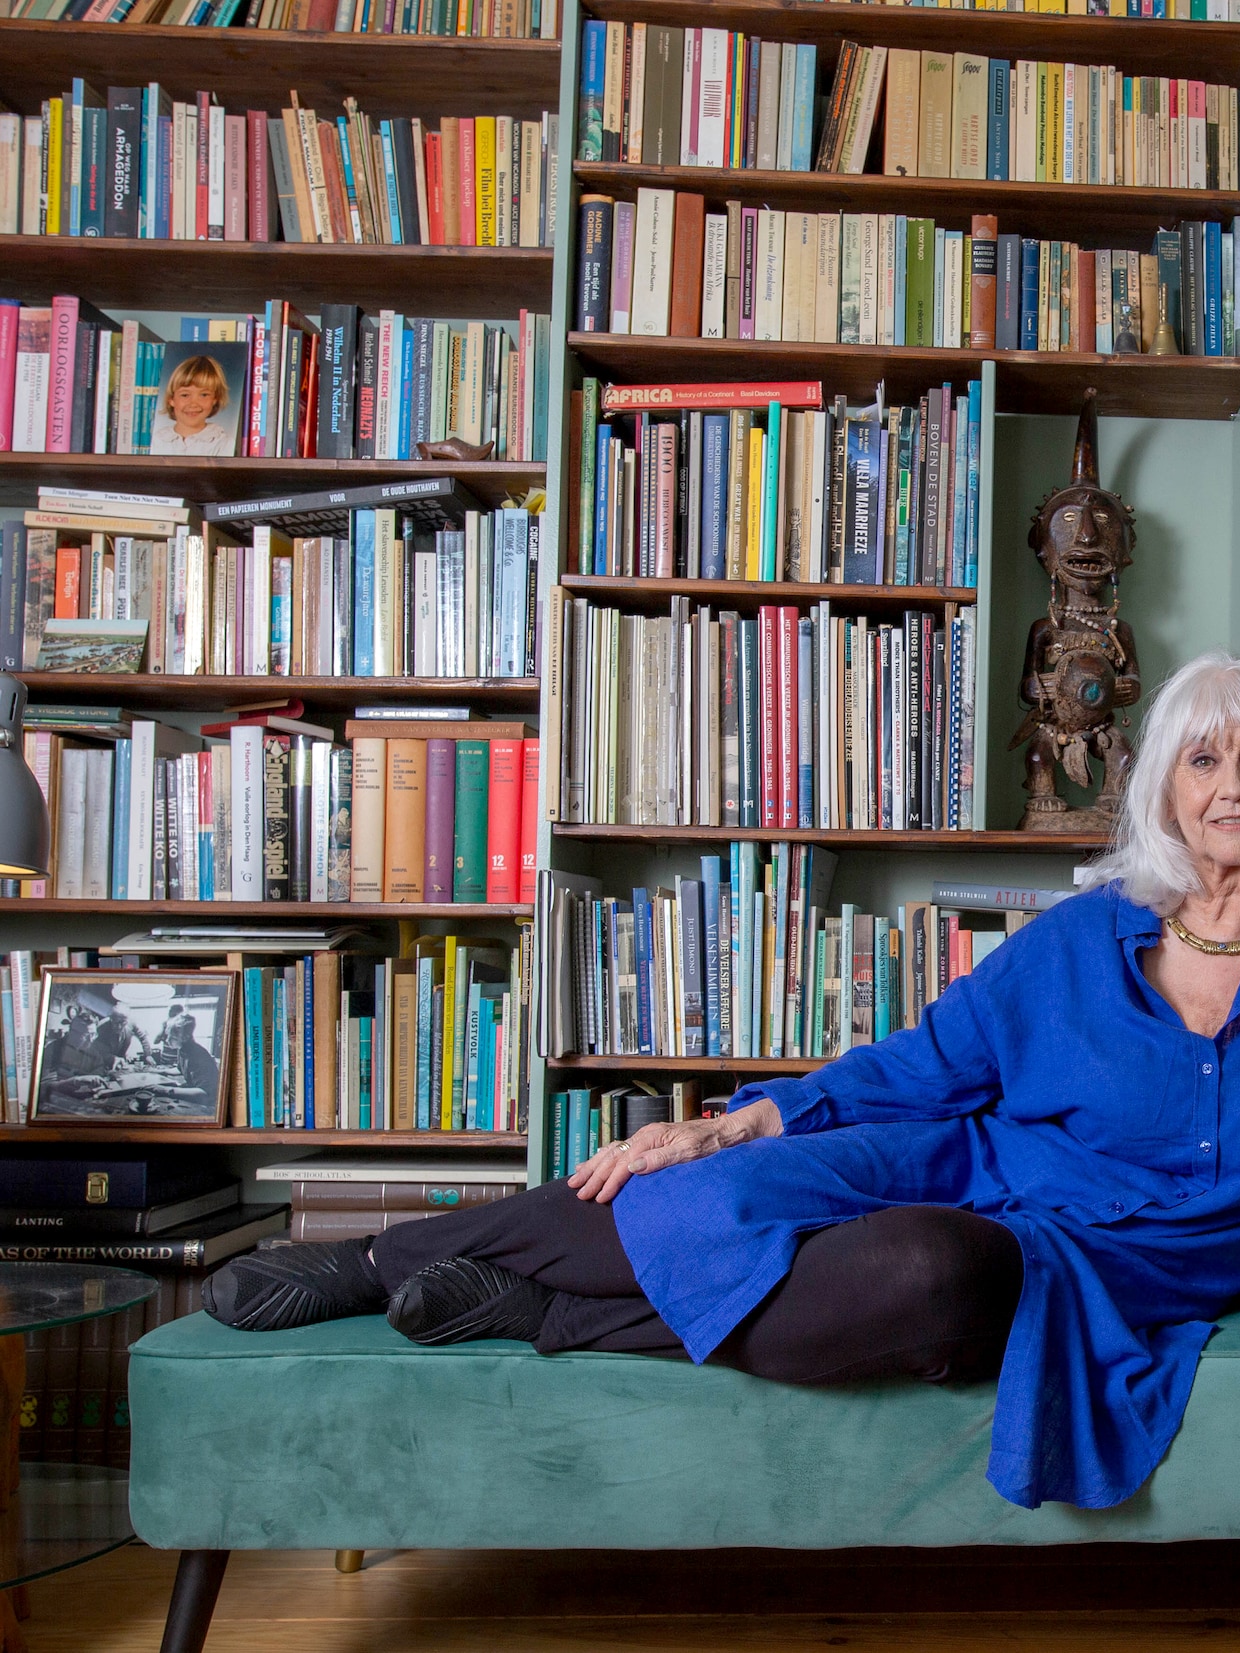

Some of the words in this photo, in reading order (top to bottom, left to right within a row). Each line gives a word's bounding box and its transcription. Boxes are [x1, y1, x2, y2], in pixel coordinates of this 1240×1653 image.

[124, 143, 131, 154] OP
[114, 128, 125, 210] ARMAGEDDON
[481, 168, 492, 192] Film
[481, 194, 492, 210] bei
[481, 212, 492, 246] Brecht
[594, 211, 603, 243] NADINE
[592, 262, 600, 276] Een
[333, 326, 343, 364] Wilhelm
[364, 332, 374, 357] Michael
[53, 313, 70, 444] OORLOGSGASTEN
[333, 377, 342, 386] in
[364, 359, 373, 384] Schmidt
[418, 373, 426, 417] RUSSISCHE
[606, 388, 672, 404] AFRICA
[331, 388, 341, 433] Nederland
[360, 387, 373, 439] NEONAZI'S
[929, 424, 939, 466] BOVEN
[856, 459, 870, 488] VILLA
[929, 474, 938, 488] DE
[329, 493, 345, 503] VOOR
[382, 488, 390, 498] DE
[392, 485, 405, 497] OUDE
[406, 482, 440, 495] HOUTHAVEN
[219, 504, 234, 516] EEN
[236, 502, 260, 514] PAPIEREN
[260, 499, 292, 513] MONUMENT
[928, 495, 937, 527] STAD
[854, 493, 869, 554] MAARHEEZE
[380, 534, 389, 574] slavenschip
[529, 526, 538, 561] COCAINE
[64, 571, 74, 598] Berlijn
[266, 754, 288, 819] England
[155, 799, 164, 838] WITTE
[168, 798, 177, 836] WITTE
[155, 841, 164, 859] KO
[168, 840, 177, 858] KO
[243, 845, 251, 862] Haag
[263, 840, 288, 880] spiel
[429, 855, 436, 866] 2
[492, 855, 504, 866] 12
[523, 854, 534, 865] 12
[457, 857, 464, 868] 3
[996, 891, 1036, 906] ATJEH
[687, 918, 696, 941] JUIST!
[687, 943, 696, 974] IJMOND
[720, 940, 730, 952] DE
[708, 923, 719, 1020] VELSEN-IJMUIDEN
[720, 954, 730, 990] VELSER
[720, 992, 730, 1029] AFFAIRE
[470, 1011, 478, 1058] KUSTVOLK
[16, 1218, 64, 1226] LANTING
[24, 1247, 48, 1260] OF
[53, 1246, 95, 1260] THE
[98, 1246, 172, 1260] WORLD
